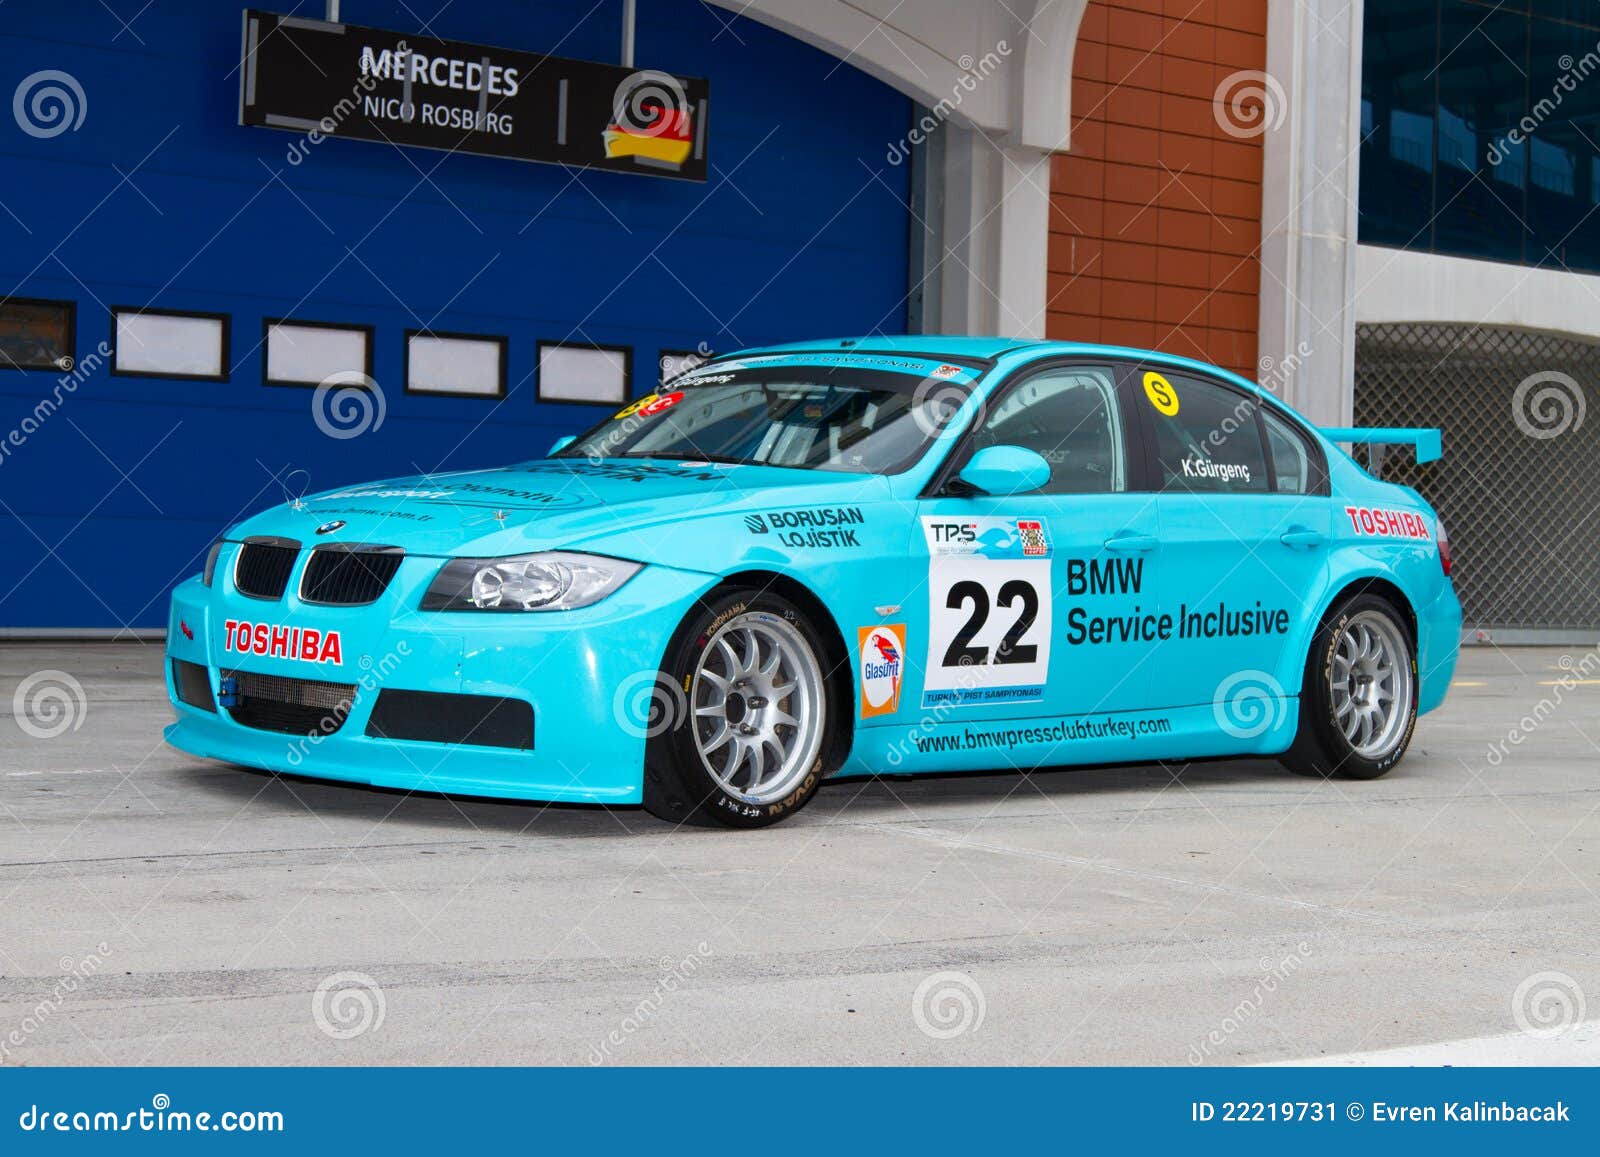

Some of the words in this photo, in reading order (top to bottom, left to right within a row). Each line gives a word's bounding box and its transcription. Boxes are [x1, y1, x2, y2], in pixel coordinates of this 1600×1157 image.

[361, 46, 519, 97] MERCEDES
[364, 95, 415, 121] NICO
[1150, 379, 1172, 407] S
[1181, 458, 1250, 482] K.Gürgenç
[767, 507, 865, 528] BORUSAN
[930, 524, 977, 543] TPS
[1344, 506, 1431, 541] TOSHIBA
[1067, 558, 1144, 595] BMW
[942, 580, 1039, 667] 22
[1066, 606, 1173, 645] Service
[1179, 601, 1289, 639] Inclusive
[224, 619, 343, 666] TOSHIBA
[915, 716, 1172, 753] www.bmwpressclubturkey.com
